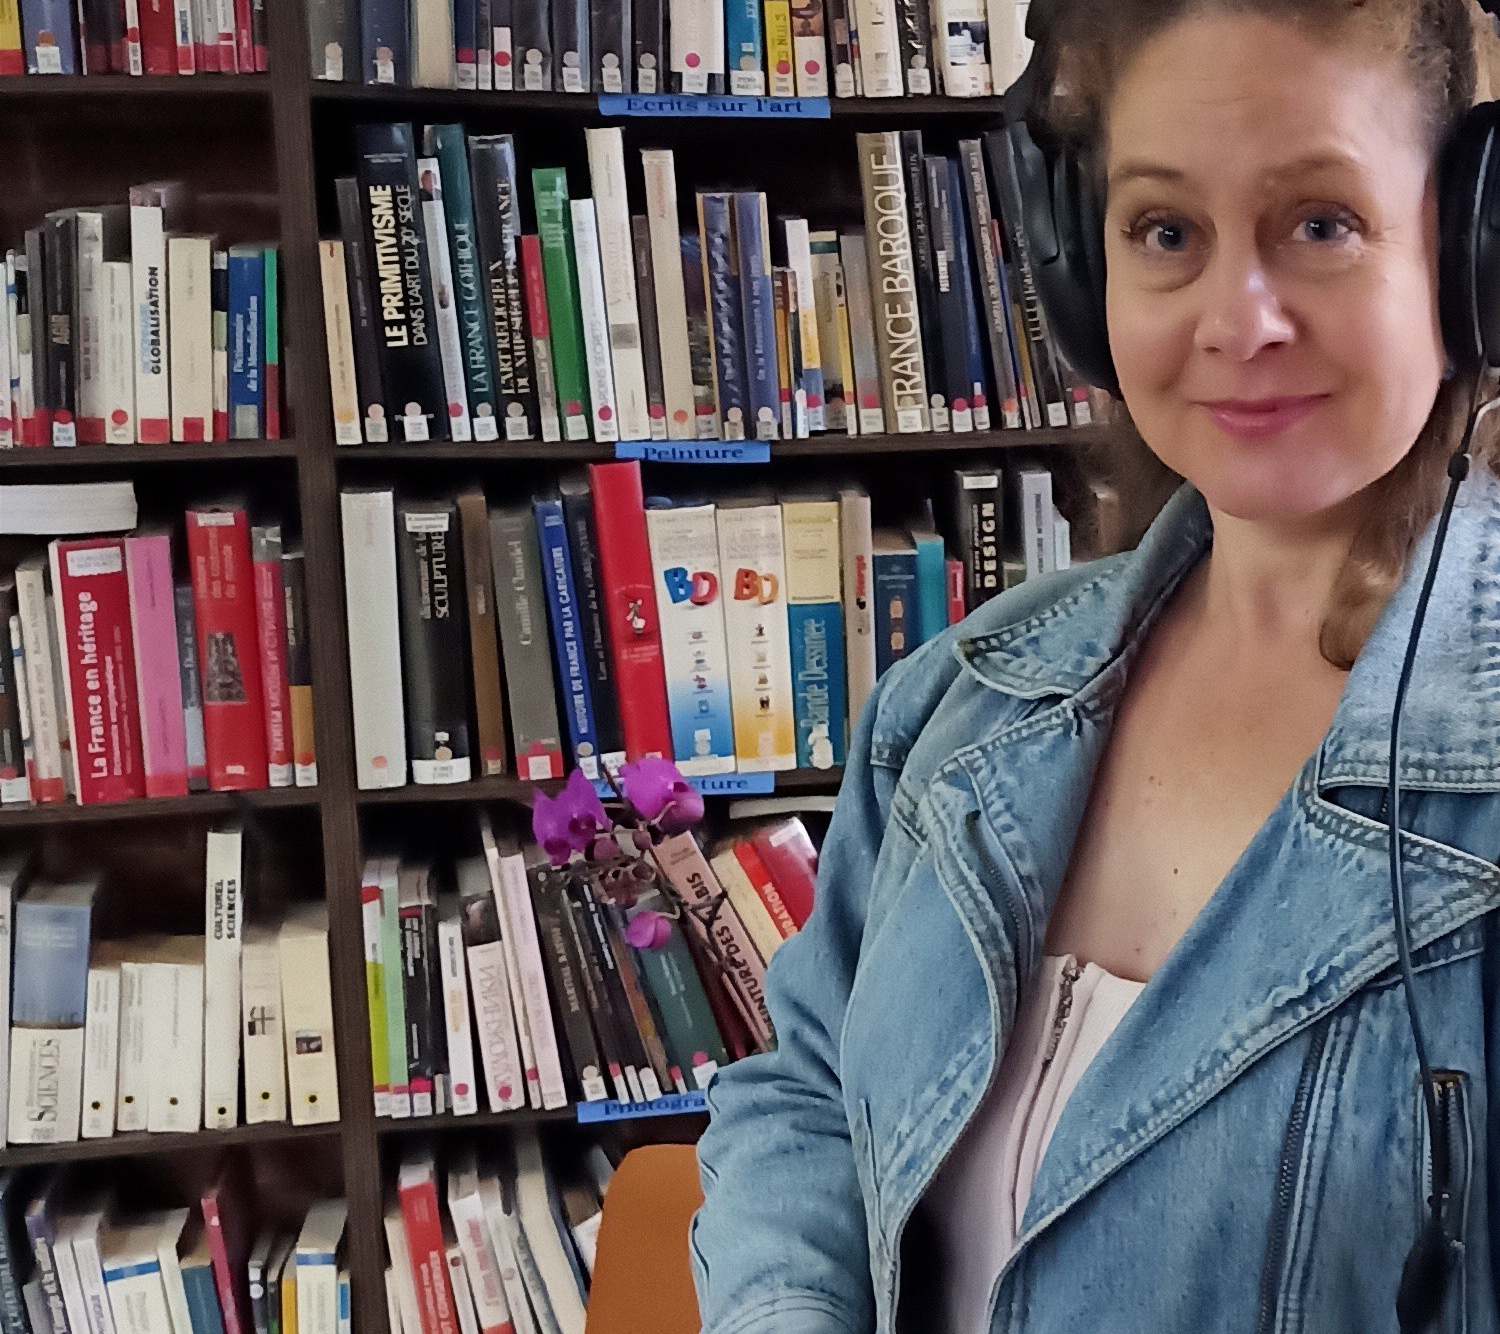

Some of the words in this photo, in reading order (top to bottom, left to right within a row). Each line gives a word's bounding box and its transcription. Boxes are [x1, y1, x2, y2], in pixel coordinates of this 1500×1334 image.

[707, 100, 748, 114] sur
[756, 98, 803, 114] l'art
[869, 152, 914, 293] BAROQUE
[369, 184, 406, 321] PRIMITIVISME
[403, 248, 421, 270] DU
[453, 220, 478, 302] GOTHIQUE
[404, 273, 423, 307] L'ART
[487, 259, 512, 349] RELIGIEUX
[147, 266, 163, 376] GLOBALISATION
[385, 324, 409, 348] LE
[409, 308, 428, 346] DANS
[462, 306, 487, 369] FRANCE
[499, 350, 517, 395] L'ART
[883, 302, 927, 411] FRANCE
[469, 370, 490, 393] LA
[596, 368, 609, 407] ARDINS
[643, 446, 745, 462] Peinture
[507, 539, 527, 592] Claudel
[981, 502, 997, 588] DESIGN
[431, 530, 451, 619] SCULPTURE
[663, 566, 718, 606] BD
[733, 567, 780, 605] BD
[76, 590, 99, 665] héritage
[515, 594, 533, 646] Camille
[560, 605, 574, 620] LA
[562, 620, 577, 639] PAR
[565, 640, 581, 678] FRANCE
[794, 618, 829, 682] Dessinée
[83, 668, 101, 691] en
[570, 678, 584, 692] DE
[85, 694, 105, 754] France
[797, 683, 831, 728] Bande
[90, 756, 109, 779] La
[226, 878, 237, 941] SCIENCES
[714, 924, 741, 956] DES
[26, 1037, 60, 1123] SCIENCES
[604, 1096, 707, 1116] Photogra
